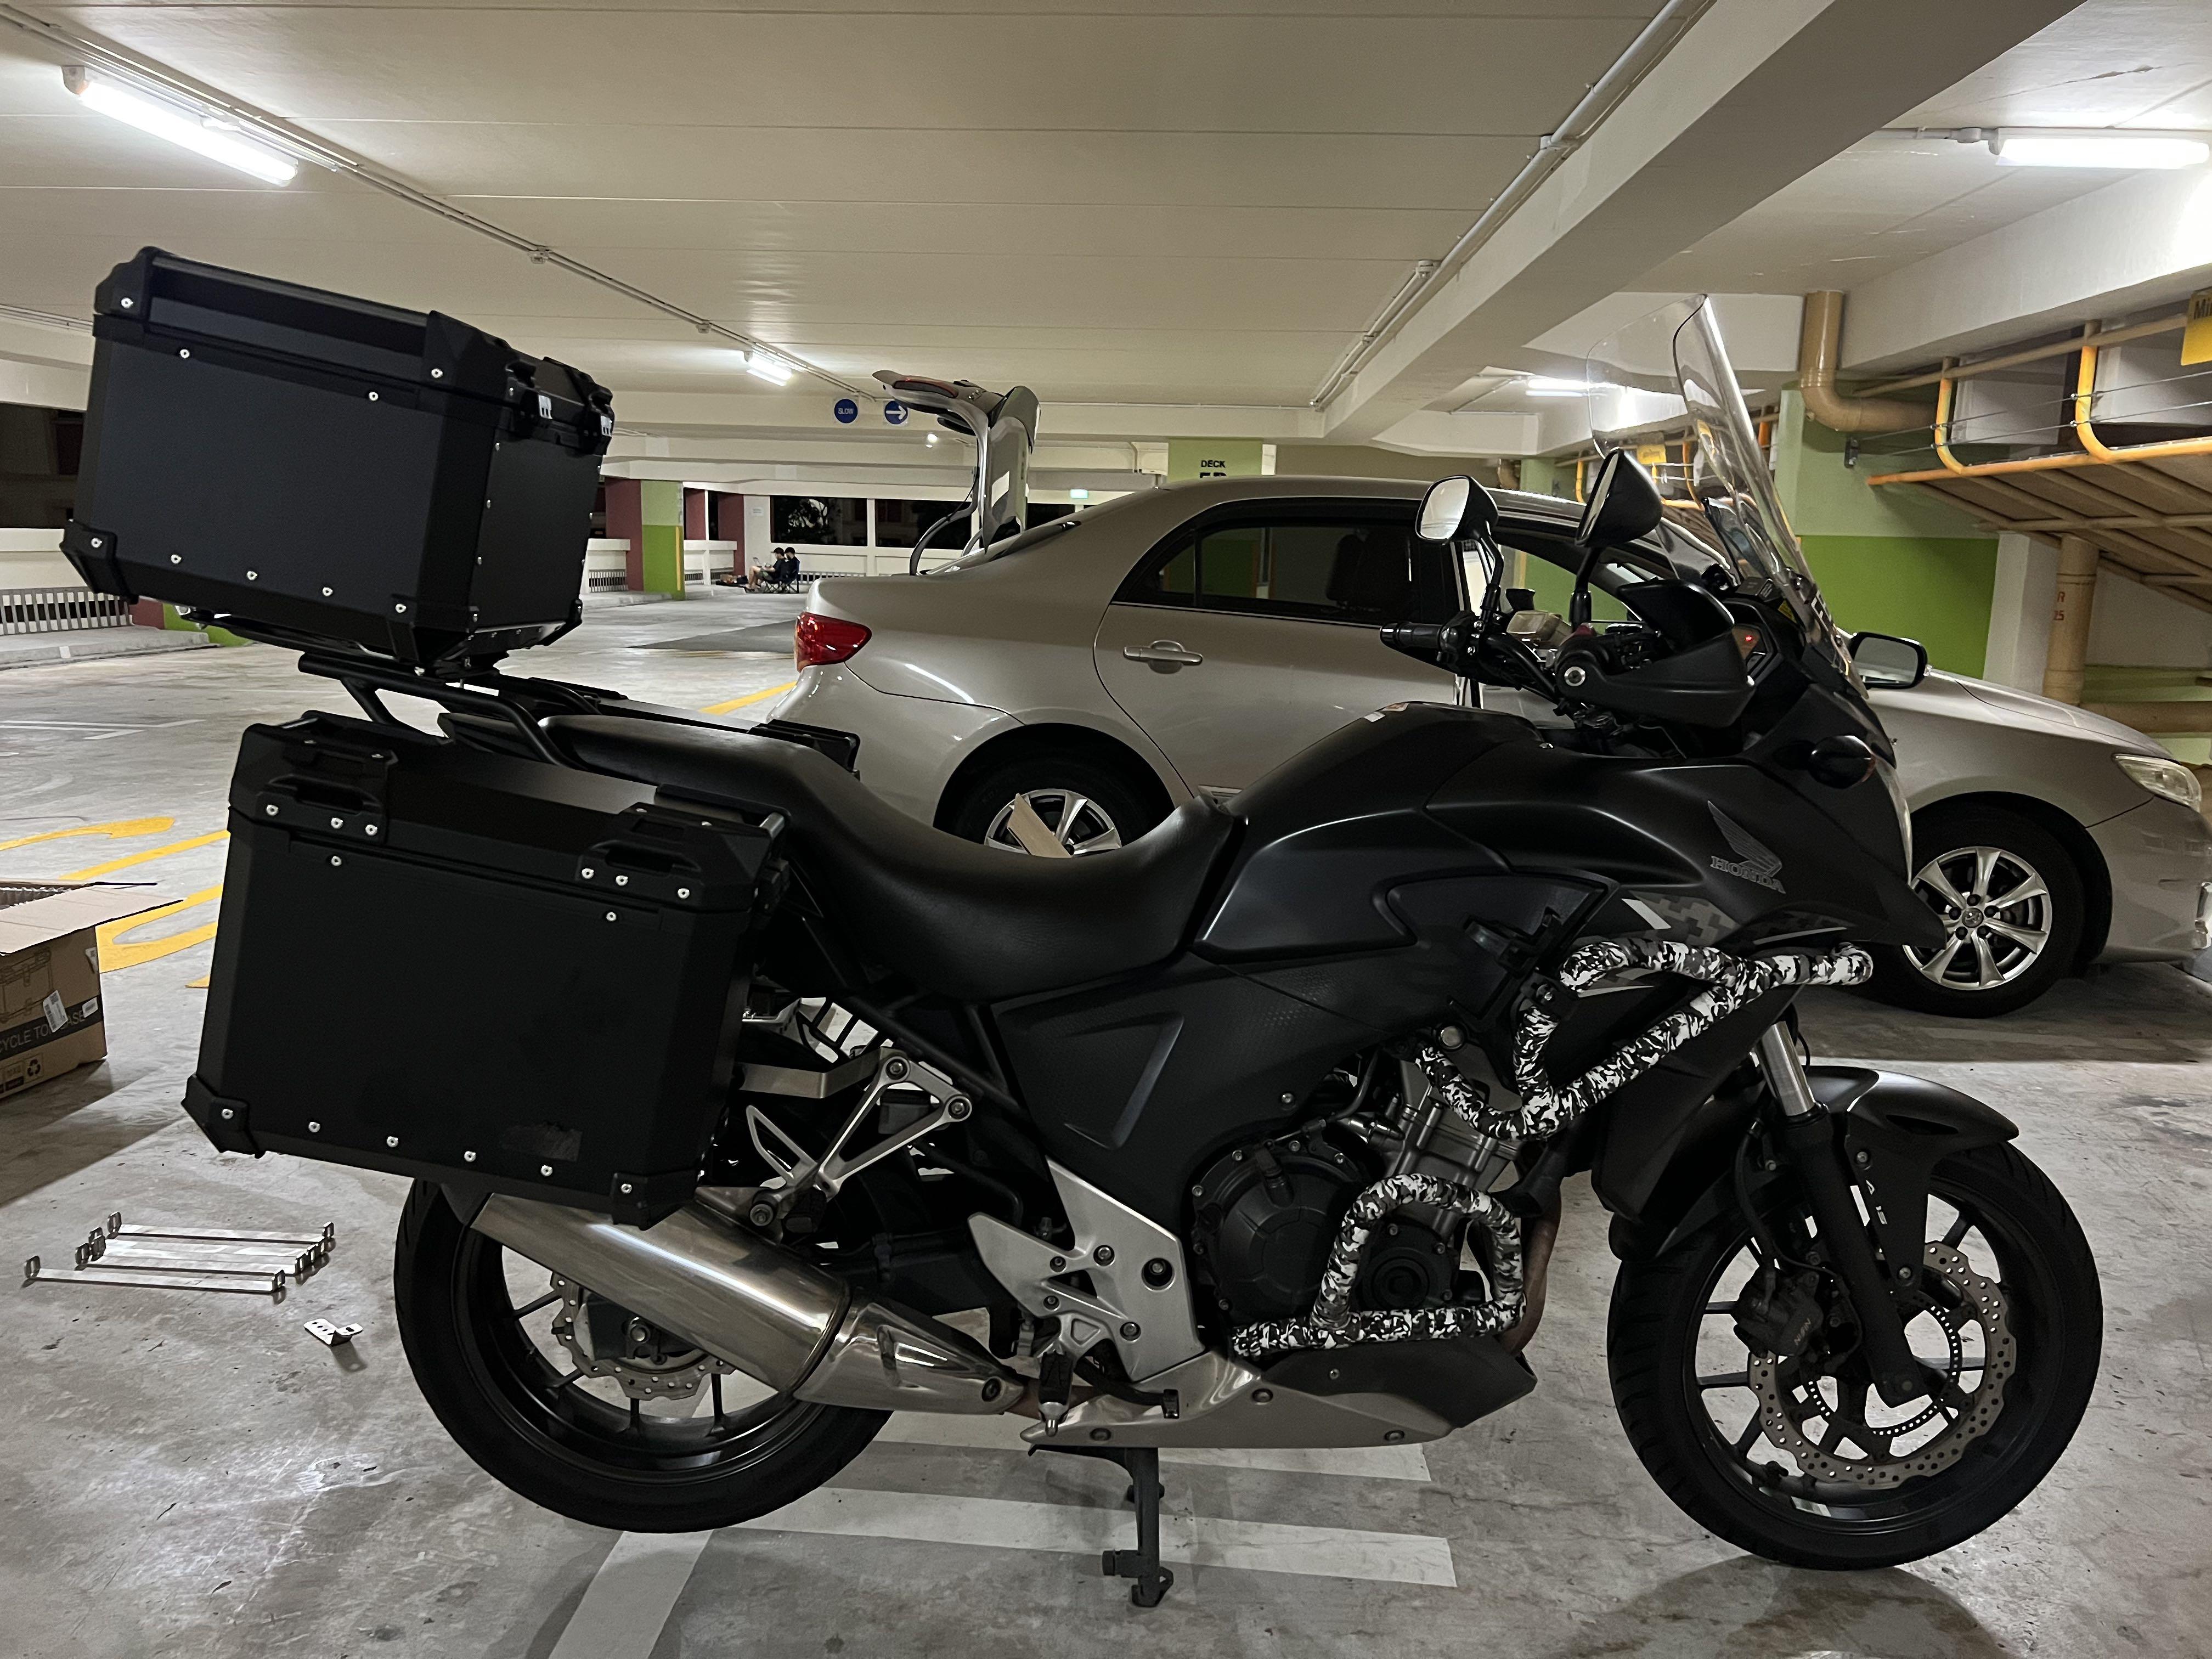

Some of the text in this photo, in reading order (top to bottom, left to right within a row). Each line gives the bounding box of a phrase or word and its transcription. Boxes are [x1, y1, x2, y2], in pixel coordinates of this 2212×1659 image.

[1201, 460, 1226, 468] DECK
[1709, 855, 1786, 894] HONDA
[0, 1029, 31, 1053] YCLE
[33, 1023, 53, 1040] TO
[59, 1009, 86, 1030] ASE
